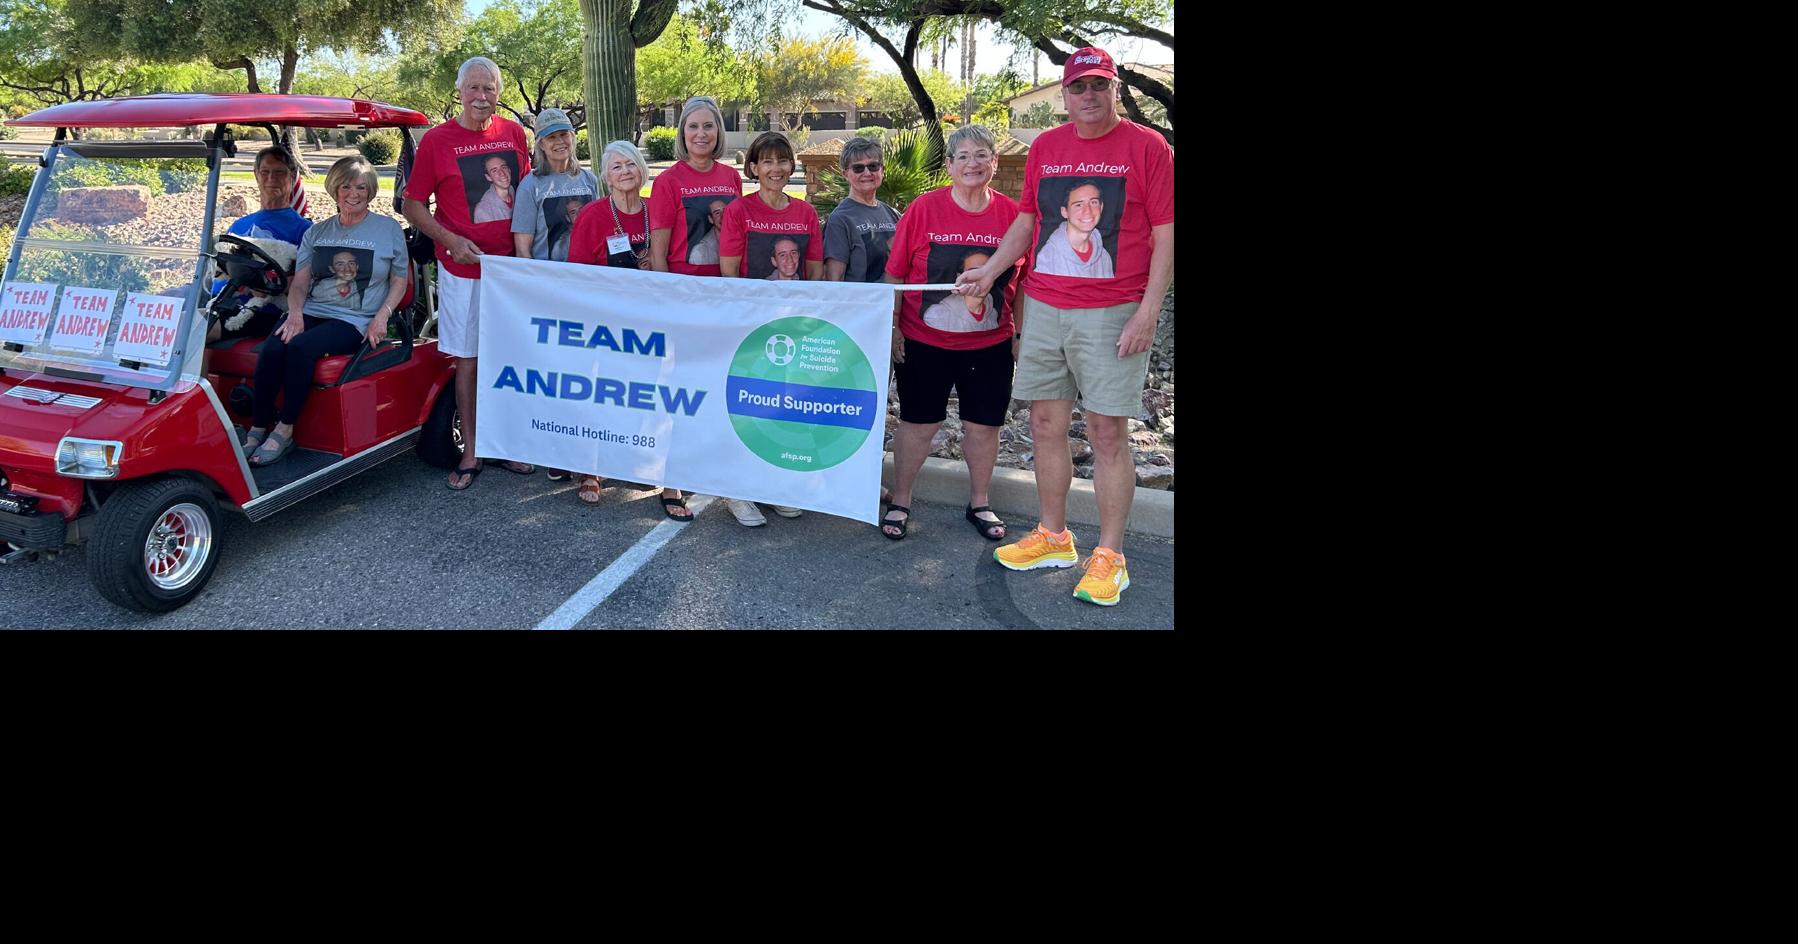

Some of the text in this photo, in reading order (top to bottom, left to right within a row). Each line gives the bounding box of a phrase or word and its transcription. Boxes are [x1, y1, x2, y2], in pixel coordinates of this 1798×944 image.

[454, 141, 514, 155] TEAM ANDREW
[1040, 161, 1130, 175] Team Andrew
[680, 185, 735, 195] TEAM ANDREW
[856, 222, 897, 232] TEAM AND
[336, 238, 376, 248] ANDREW
[928, 232, 1003, 245] Team Andre
[14, 290, 49, 305] TEAM
[72, 295, 109, 312] TEAM
[137, 303, 174, 320] TEAM
[0, 309, 50, 330] ANDREW
[56, 314, 110, 337] ANDREW
[119, 322, 176, 347] ANDREW
[530, 316, 666, 358] TEAM
[802, 335, 836, 346] American
[801, 344, 841, 355] Foundation
[809, 354, 837, 364] Suicide
[799, 361, 839, 373] Prevention
[492, 365, 708, 417] ANDREW
[738, 389, 863, 416] Proud Supporter
[531, 418, 656, 448] National Hotline: 988
[780, 451, 813, 463] afsp.org
